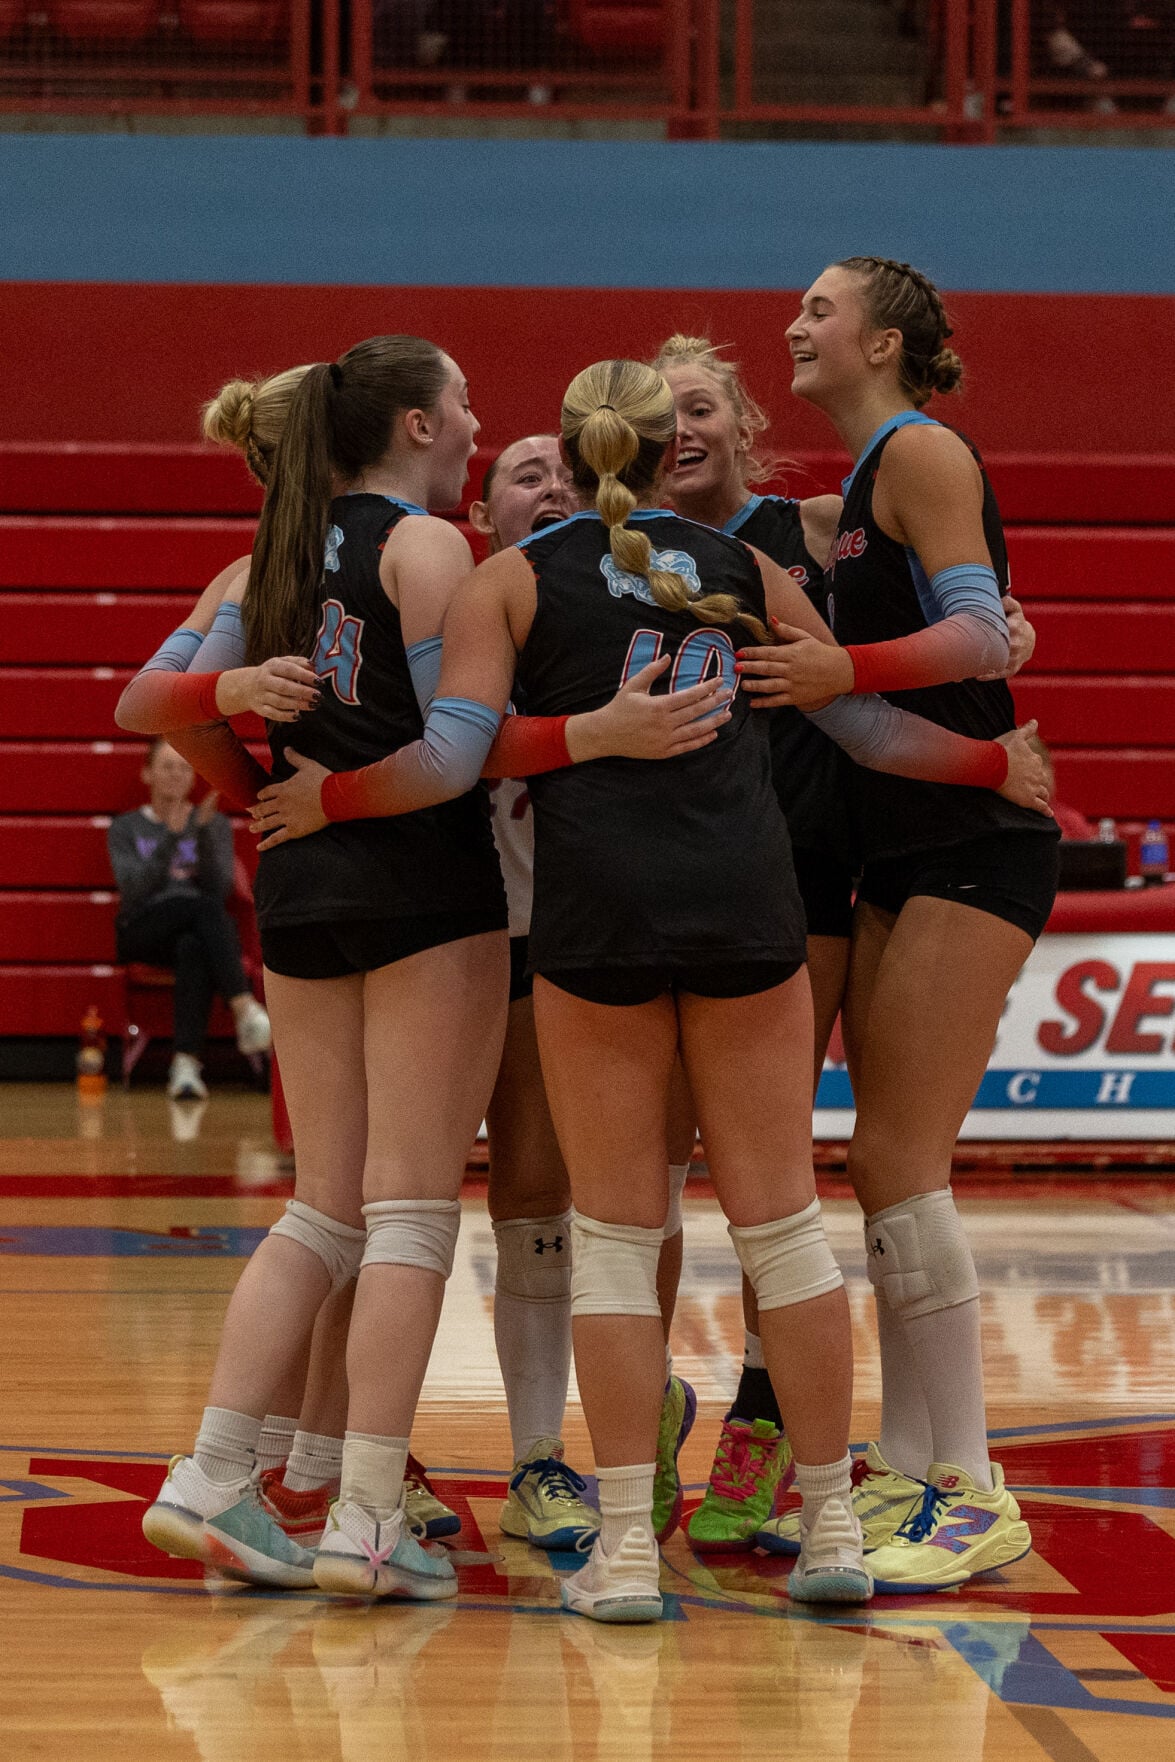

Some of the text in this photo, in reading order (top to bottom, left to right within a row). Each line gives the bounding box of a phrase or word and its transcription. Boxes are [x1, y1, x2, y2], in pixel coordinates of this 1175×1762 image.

[310, 599, 365, 706] 4
[619, 627, 740, 721] 10
[1036, 957, 1175, 1058] SE
